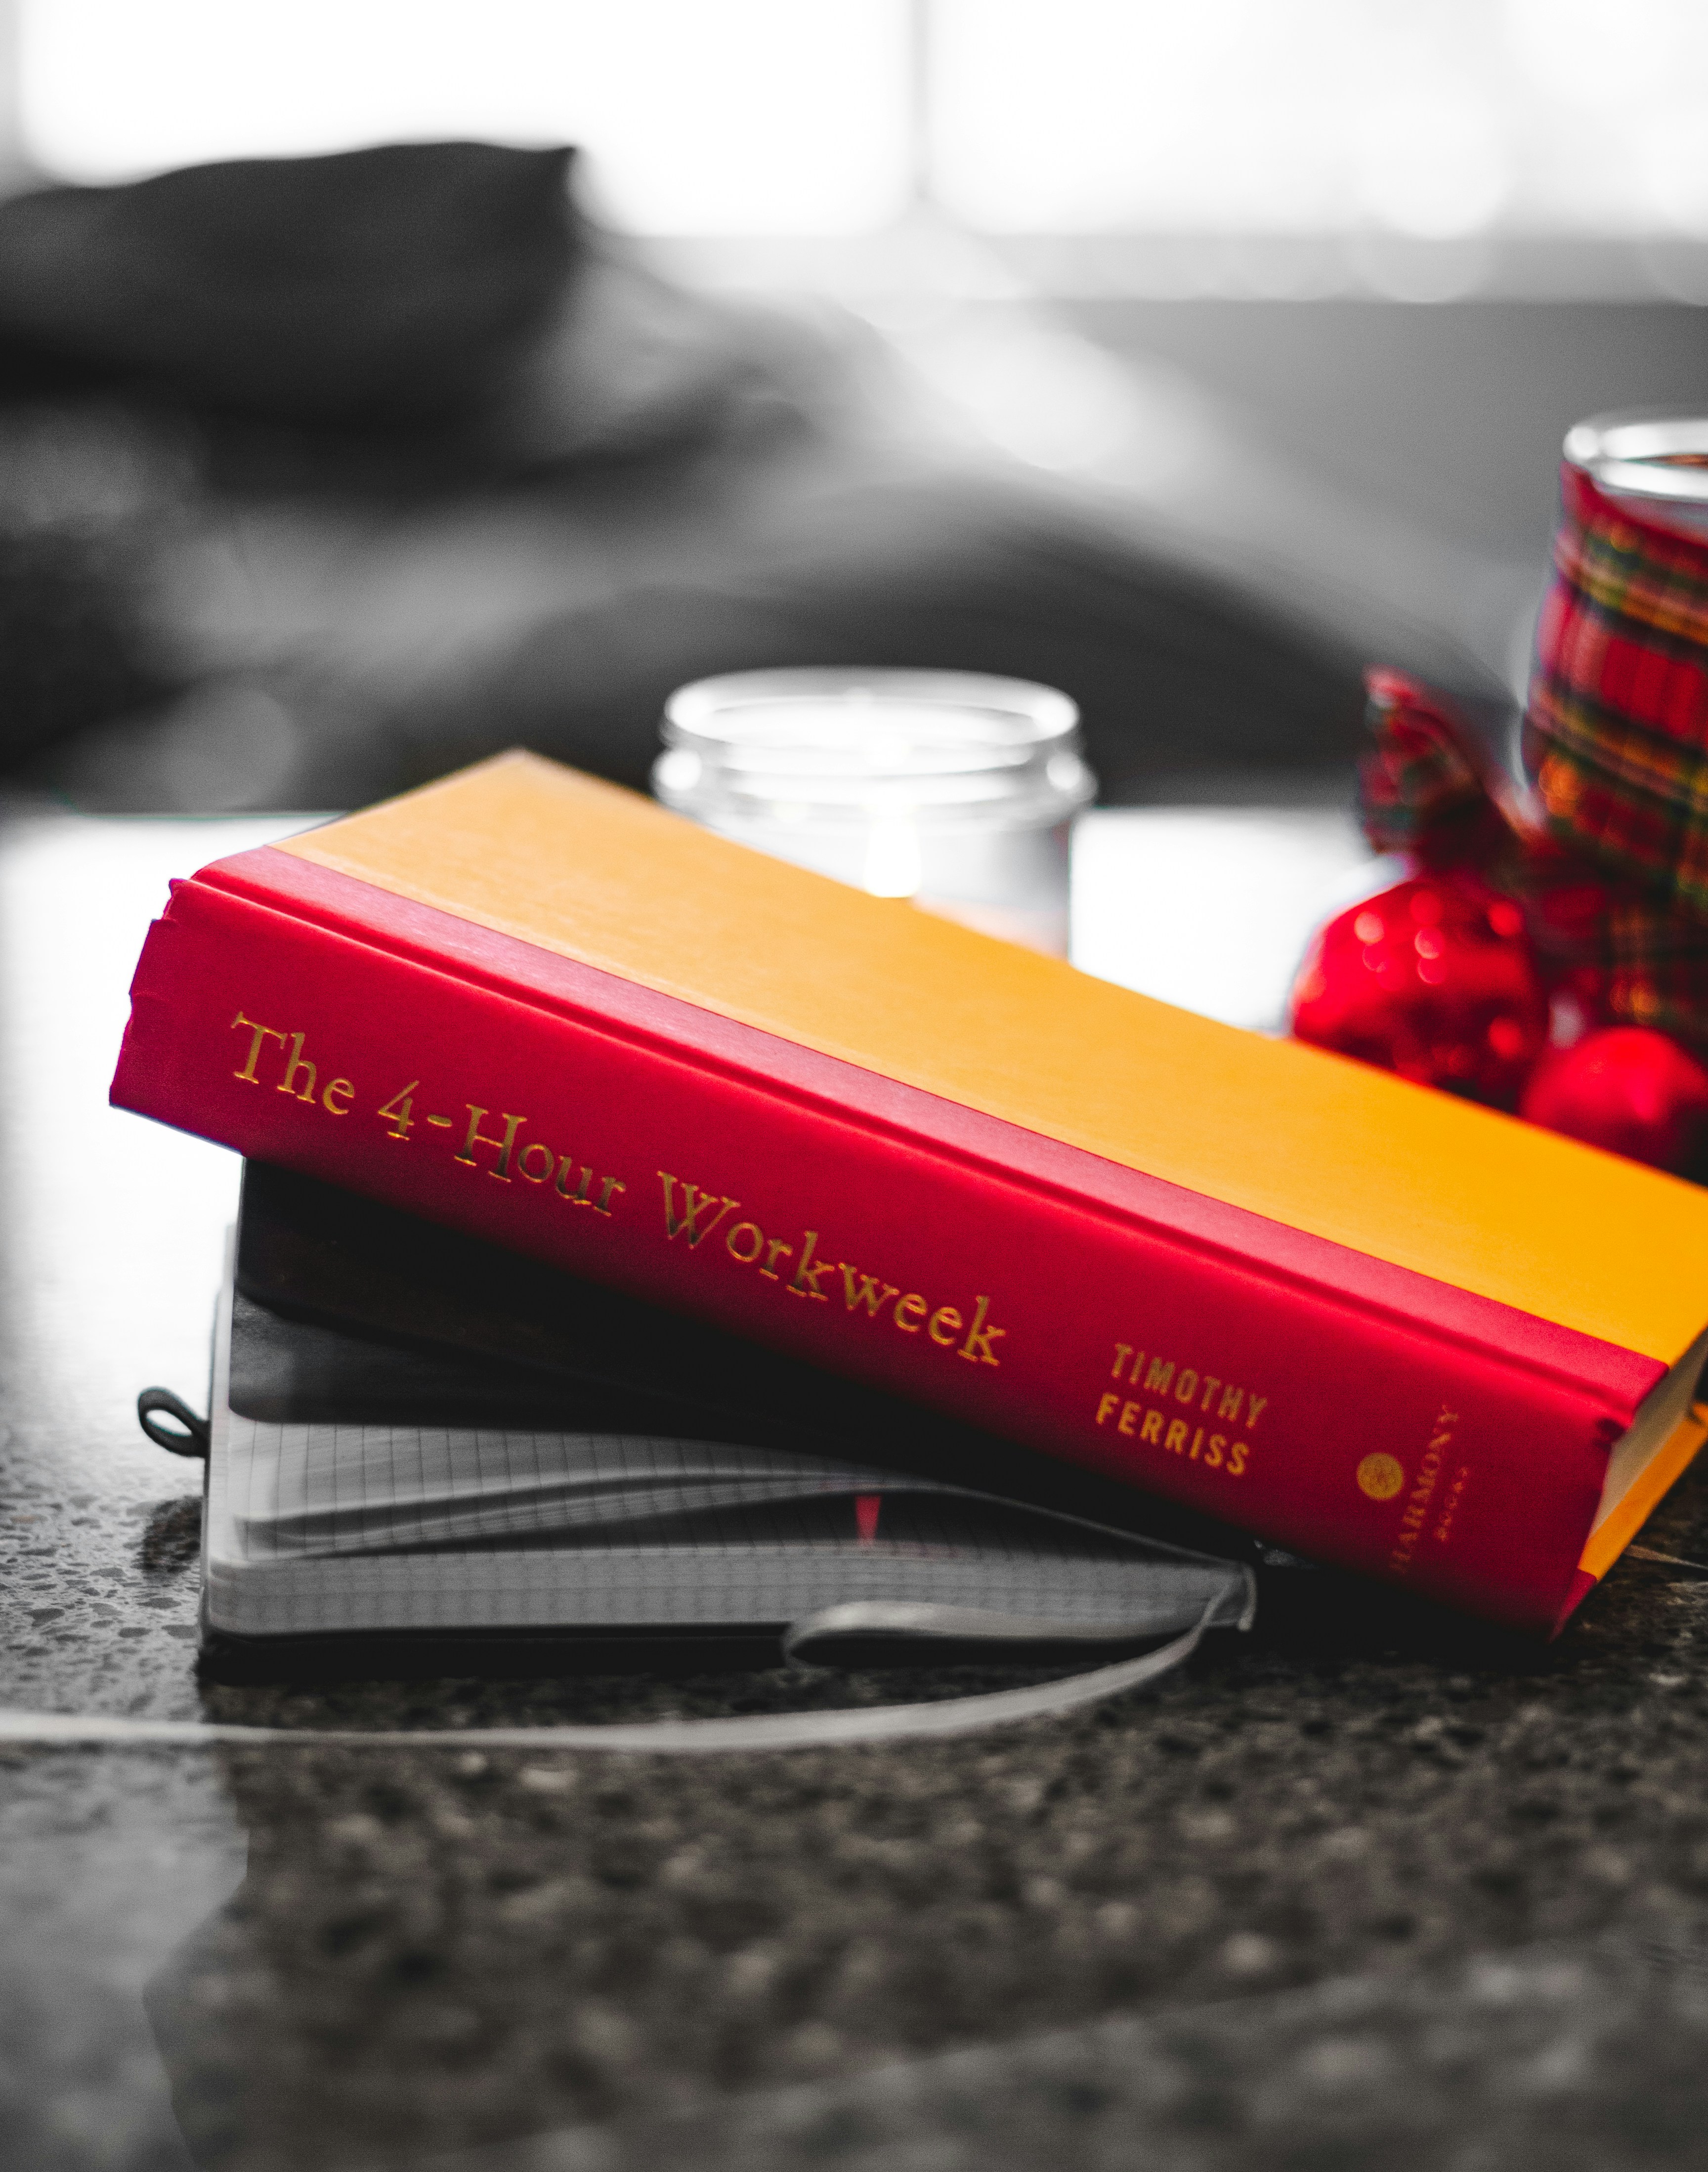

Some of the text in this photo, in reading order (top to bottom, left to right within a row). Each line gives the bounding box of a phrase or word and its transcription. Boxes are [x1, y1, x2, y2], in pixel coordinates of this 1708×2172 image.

[231, 1011, 1006, 1365] The 4-Hour Workweek
[1111, 1342, 1268, 1428] TIMOTHY
[1096, 1392, 1249, 1476] FERRISS
